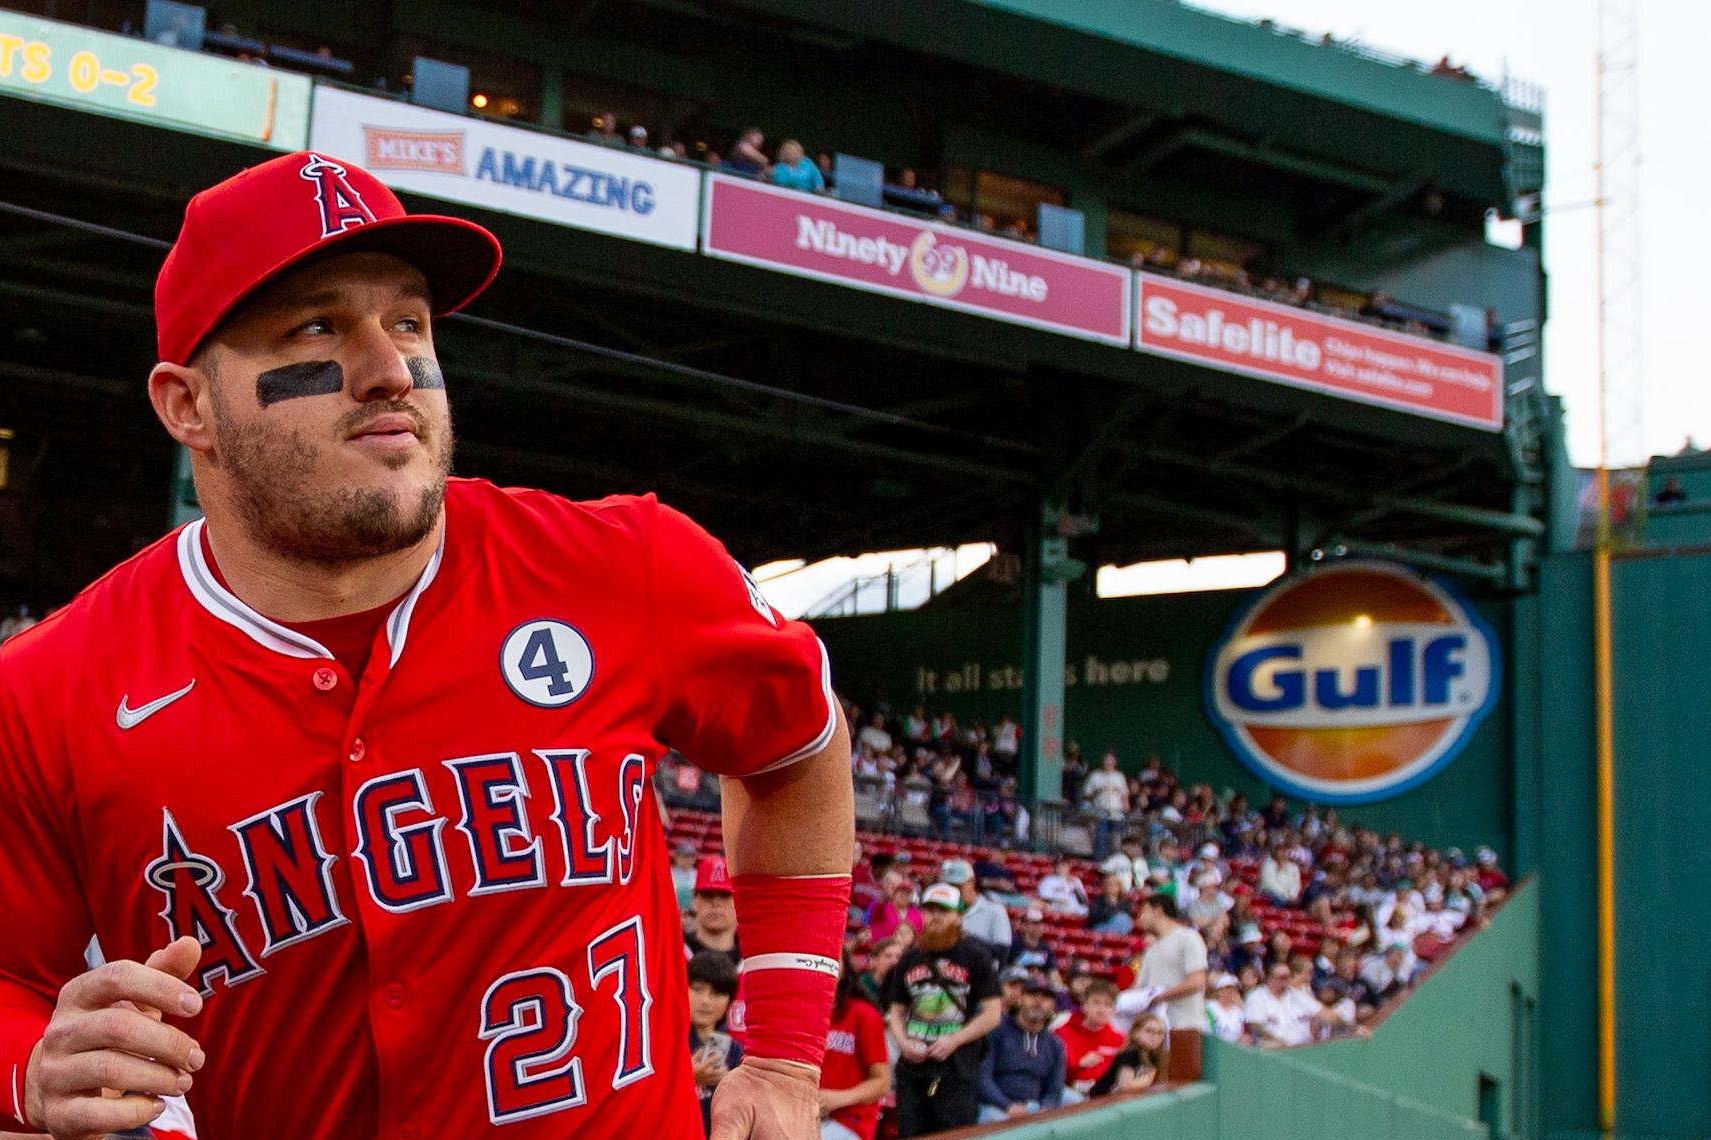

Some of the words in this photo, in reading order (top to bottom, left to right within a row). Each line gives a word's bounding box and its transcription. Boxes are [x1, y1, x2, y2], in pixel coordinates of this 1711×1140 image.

[69, 51, 158, 107] 0-2
[300, 152, 377, 240] A
[377, 135, 457, 165] MIKE'S
[475, 146, 655, 216] AMAZING
[796, 214, 909, 276] Ninety
[971, 254, 1048, 303] Nine
[1145, 295, 1322, 371] Safelite
[517, 627, 576, 697] 4
[945, 662, 981, 694] all
[1084, 656, 1170, 685] here
[1225, 633, 1468, 713] Gulf
[145, 747, 645, 999] ANGELS
[478, 914, 656, 1127] 27
